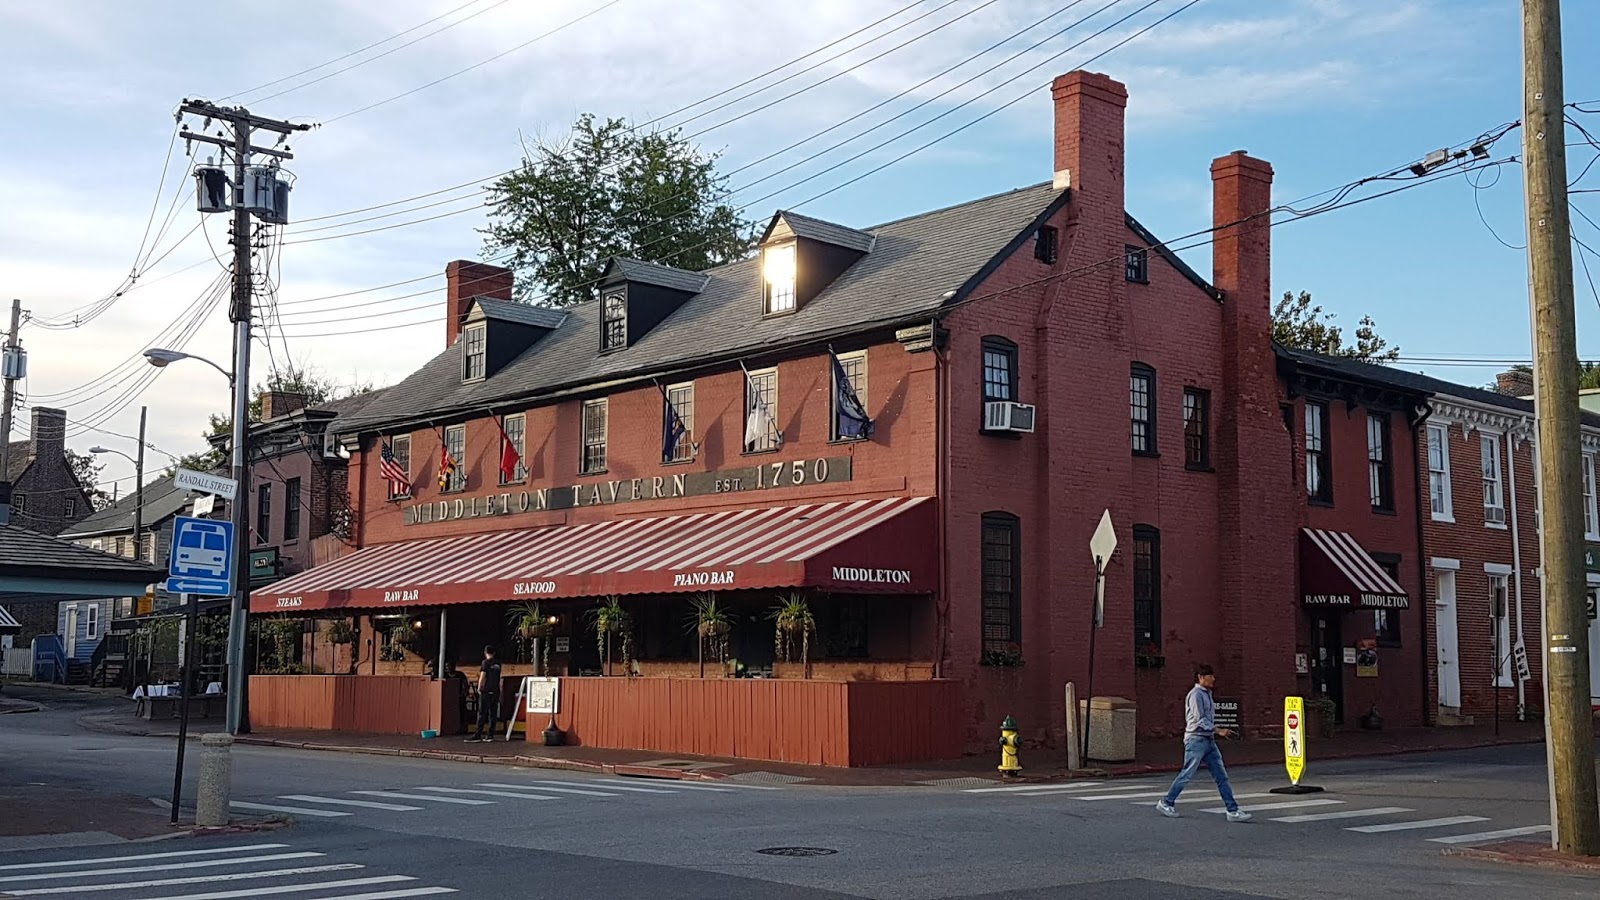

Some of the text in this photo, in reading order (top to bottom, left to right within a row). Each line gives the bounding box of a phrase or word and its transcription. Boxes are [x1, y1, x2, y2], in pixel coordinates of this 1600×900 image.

[178, 473, 234, 494] RANDALL STREET
[411, 457, 829, 523] MIDDLETON TAVERN EST. 1750
[673, 571, 735, 586] PIANO BAR
[832, 567, 911, 584] MIDDLETON
[384, 589, 419, 602] RAW BAR
[513, 582, 556, 595] SEAFOOD
[276, 597, 302, 607] STEAKS
[1305, 595, 1350, 604] RAW BAR
[1361, 594, 1409, 608] MIDDLETON
